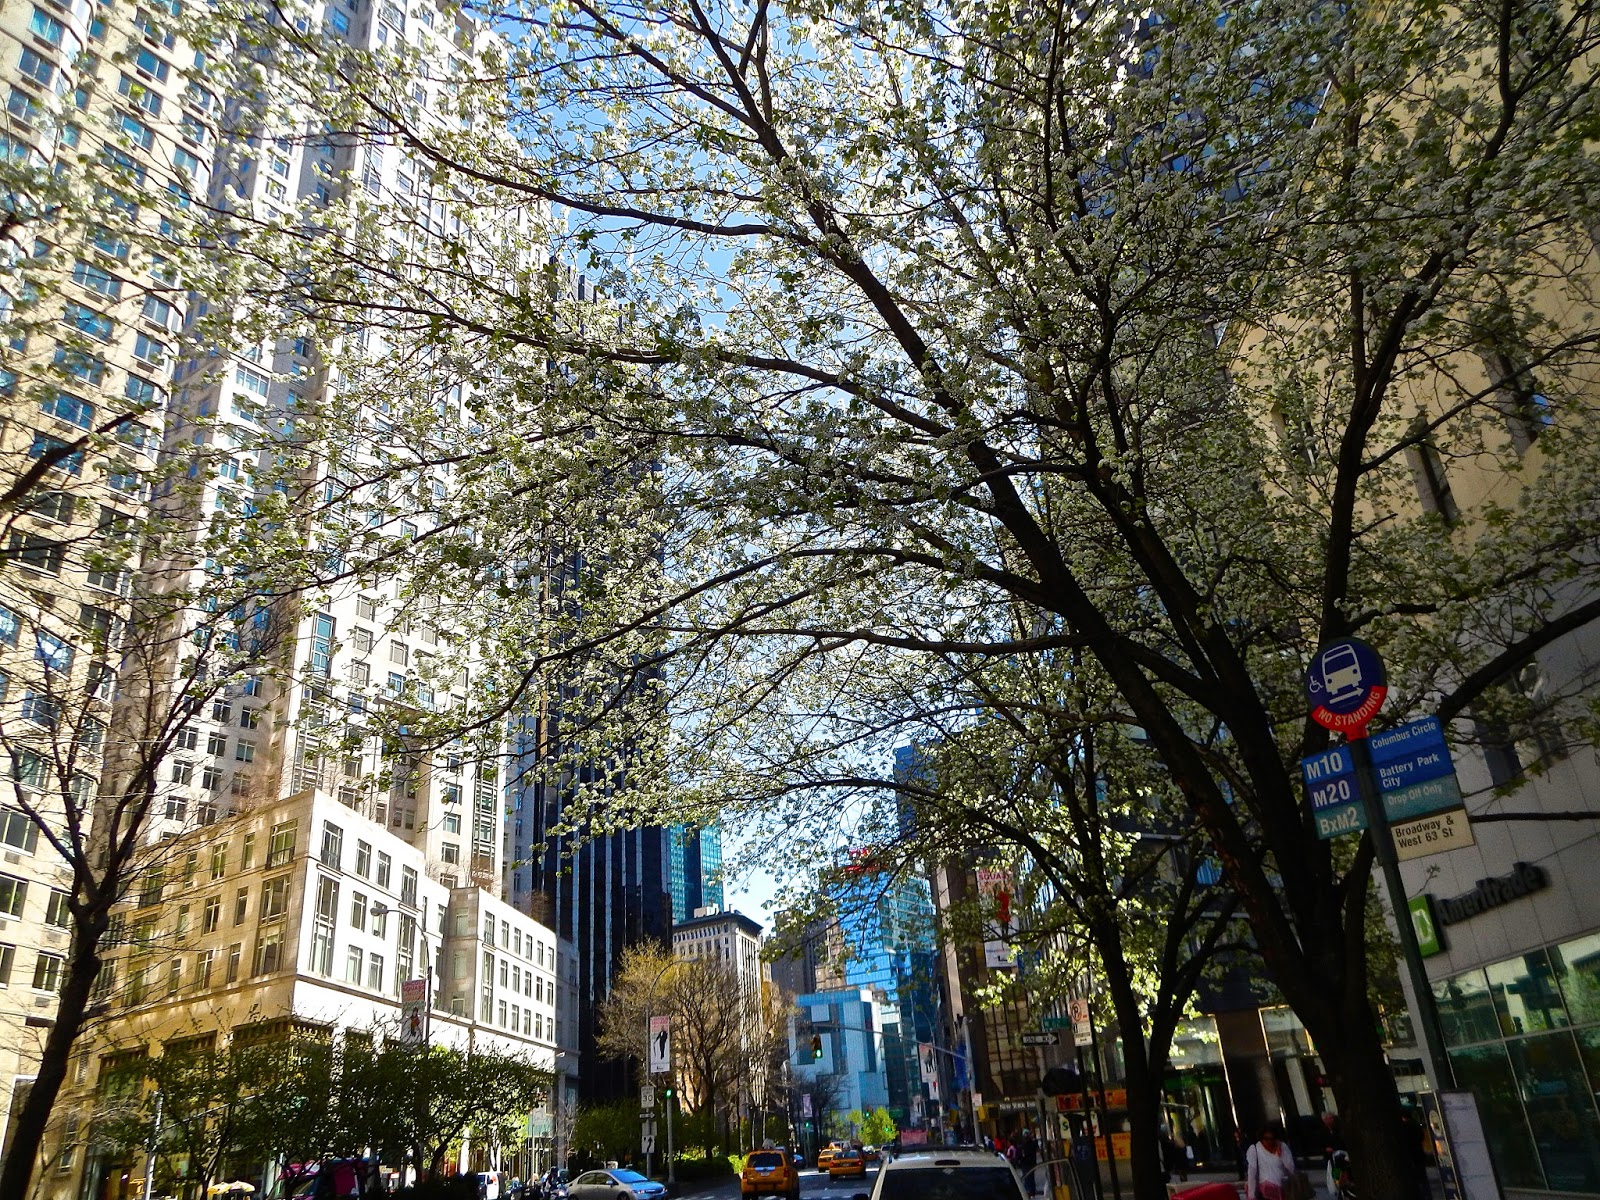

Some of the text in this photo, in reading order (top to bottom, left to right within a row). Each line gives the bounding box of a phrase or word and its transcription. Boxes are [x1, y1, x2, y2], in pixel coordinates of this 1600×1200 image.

[1318, 691, 1381, 726] NO STANDING
[1371, 721, 1437, 749] Columbus Circle
[1306, 752, 1343, 780] M10
[1379, 752, 1440, 778] Battery Park
[1313, 779, 1350, 808] M20
[1382, 776, 1401, 789] City
[1388, 783, 1443, 806] Drop Off Only
[1319, 806, 1360, 835] BxM2
[1395, 815, 1454, 838] Broadway &
[1398, 827, 1454, 848] West 63 St
[643, 1094, 654, 1103] 30
